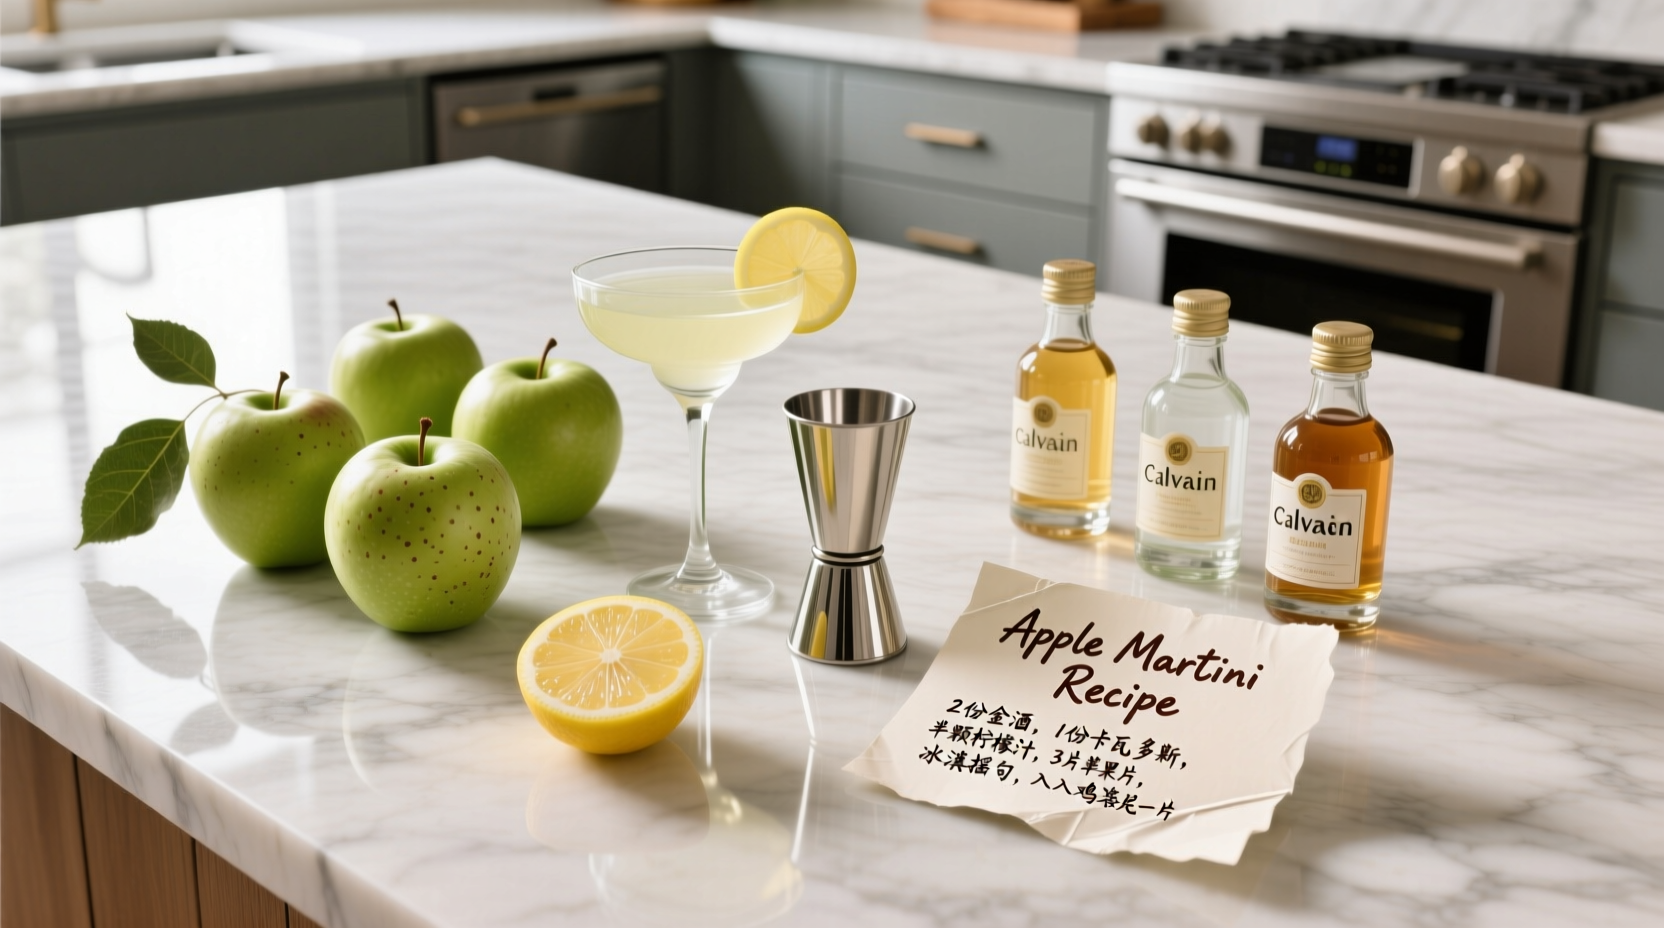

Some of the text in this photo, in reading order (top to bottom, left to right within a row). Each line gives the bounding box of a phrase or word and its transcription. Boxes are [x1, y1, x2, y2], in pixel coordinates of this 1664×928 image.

[1015, 427, 1078, 453] Calvain
[1144, 463, 1217, 491] Calvain
[999, 608, 1265, 690] Apple Martini
[1052, 664, 1180, 725] Recipe
